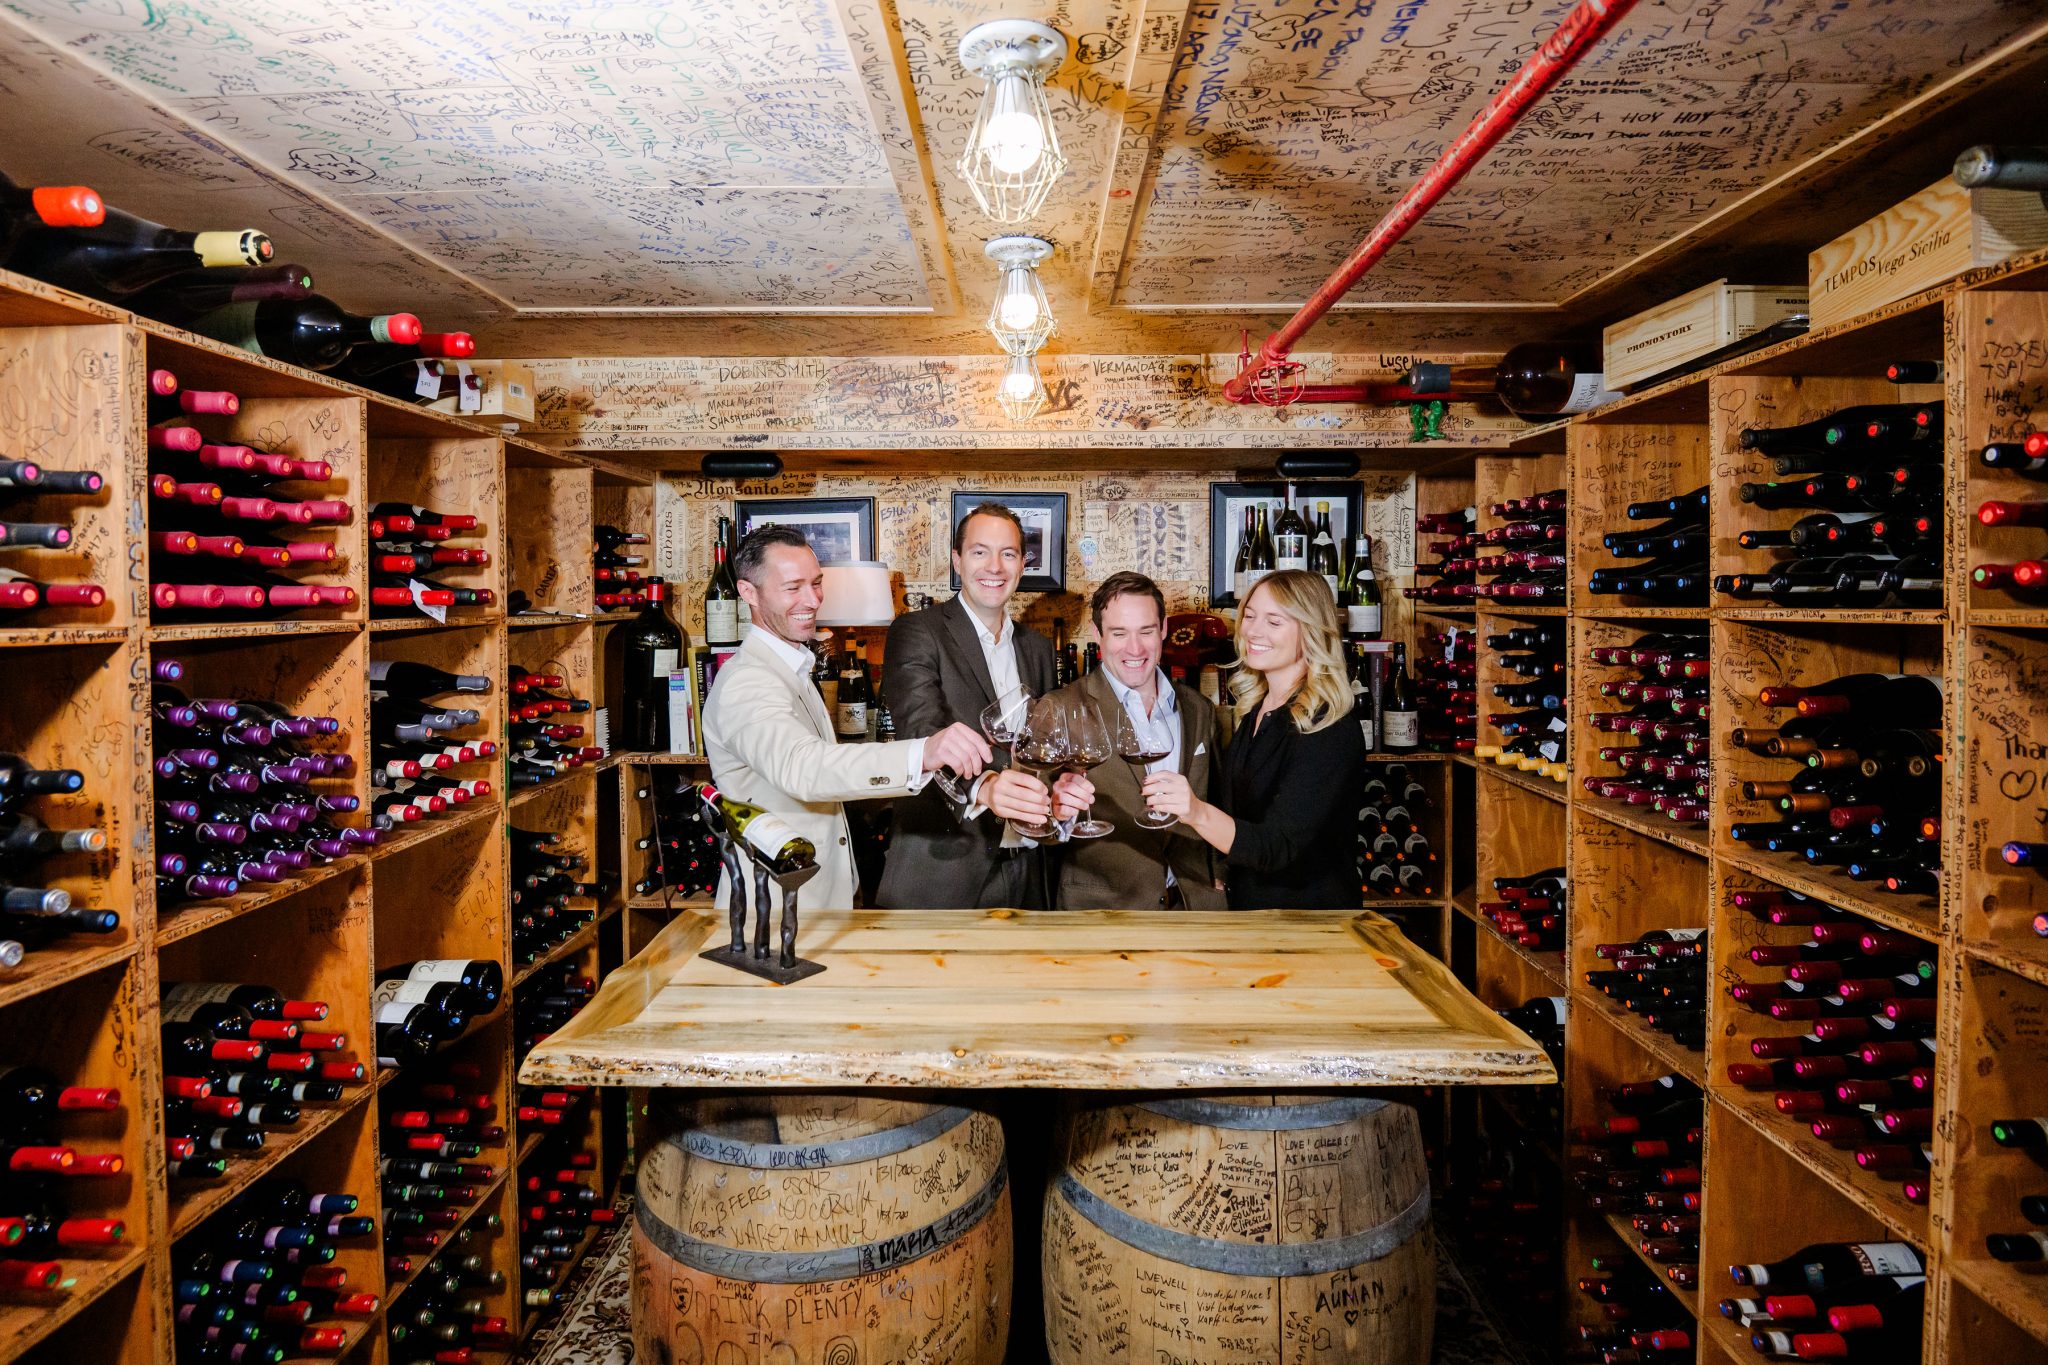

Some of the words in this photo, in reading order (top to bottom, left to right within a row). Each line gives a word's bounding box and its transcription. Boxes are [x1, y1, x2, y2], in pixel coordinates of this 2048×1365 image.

[1825, 256, 1877, 292] TEMPOS
[1877, 254, 1905, 278] Vega
[1910, 230, 1952, 259] Sicilia
[1626, 323, 1693, 354] PROMONTORY
[694, 480, 779, 498] Monsanto
[1219, 1137, 1249, 1150] LOVE
[1218, 1163, 1254, 1176] AWESOME
[716, 1277, 749, 1293] Kenny
[794, 1283, 834, 1298] CHLOE
[1141, 1285, 1167, 1299] LOVE
[735, 1291, 753, 1300] Mac
[1315, 1279, 1385, 1316] AUMAN
[695, 1290, 771, 1330] DRINK
[785, 1288, 862, 1330] PLENTY
[1160, 1301, 1187, 1314] LIFE!
[1139, 1313, 1175, 1338] Wendy
[1184, 1329, 1206, 1344] Jim
[747, 1332, 773, 1345] IN
